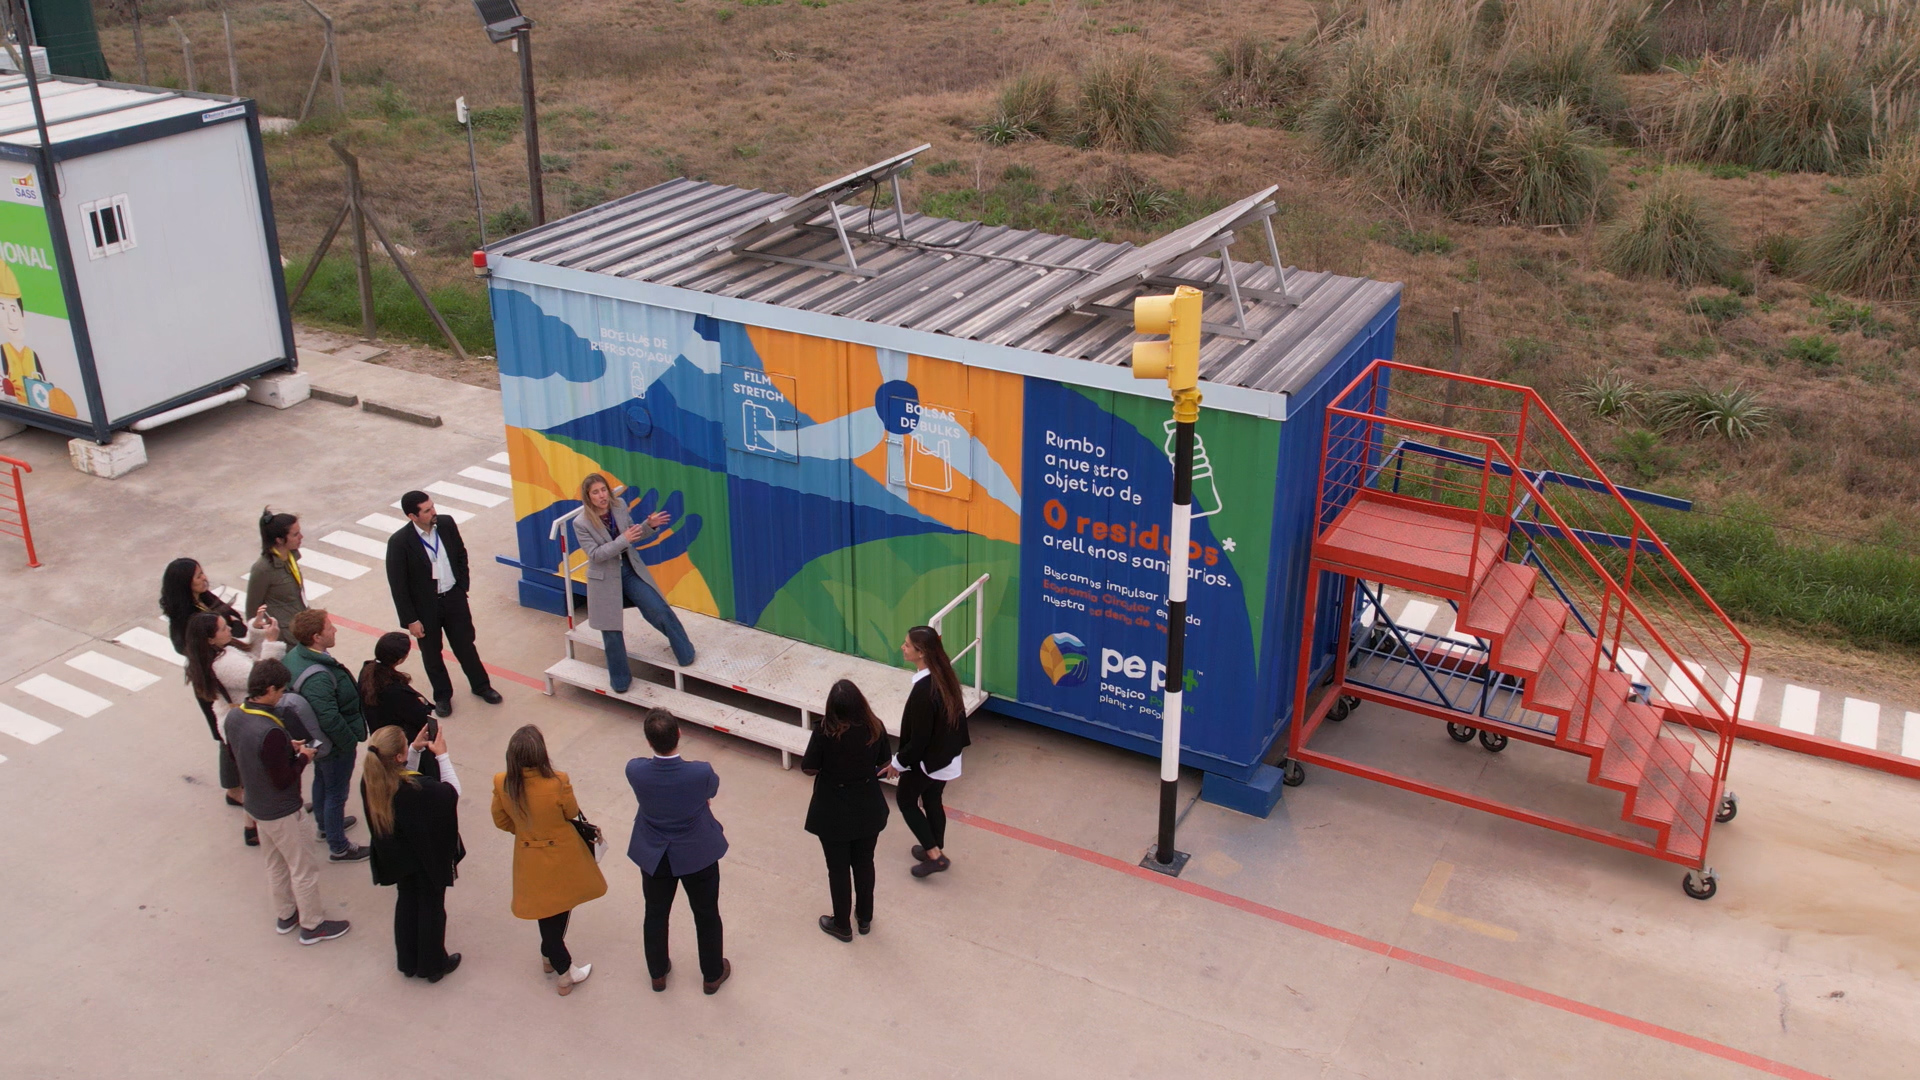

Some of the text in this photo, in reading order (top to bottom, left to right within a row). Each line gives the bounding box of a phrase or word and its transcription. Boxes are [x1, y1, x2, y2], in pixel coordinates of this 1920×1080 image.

[15, 188, 37, 200] SASS
[653, 337, 668, 349] DE
[744, 371, 771, 386] FILM
[733, 383, 784, 403] STRETCH
[905, 402, 955, 422] BOLSAS
[900, 416, 961, 439] DE BULKS
[1046, 430, 1106, 458] Rumbo
[1044, 471, 1142, 505] objetivo de
[1131, 555, 1232, 588] saniarios.
[1044, 565, 1102, 590] Buscamos
[1106, 580, 1159, 602] impulsar
[1043, 594, 1085, 612] nuestra
[1135, 616, 1151, 628] de
[1102, 593, 1151, 613] Circular
[1100, 682, 1146, 701] pepsico
[1139, 706, 1164, 720] peopl
